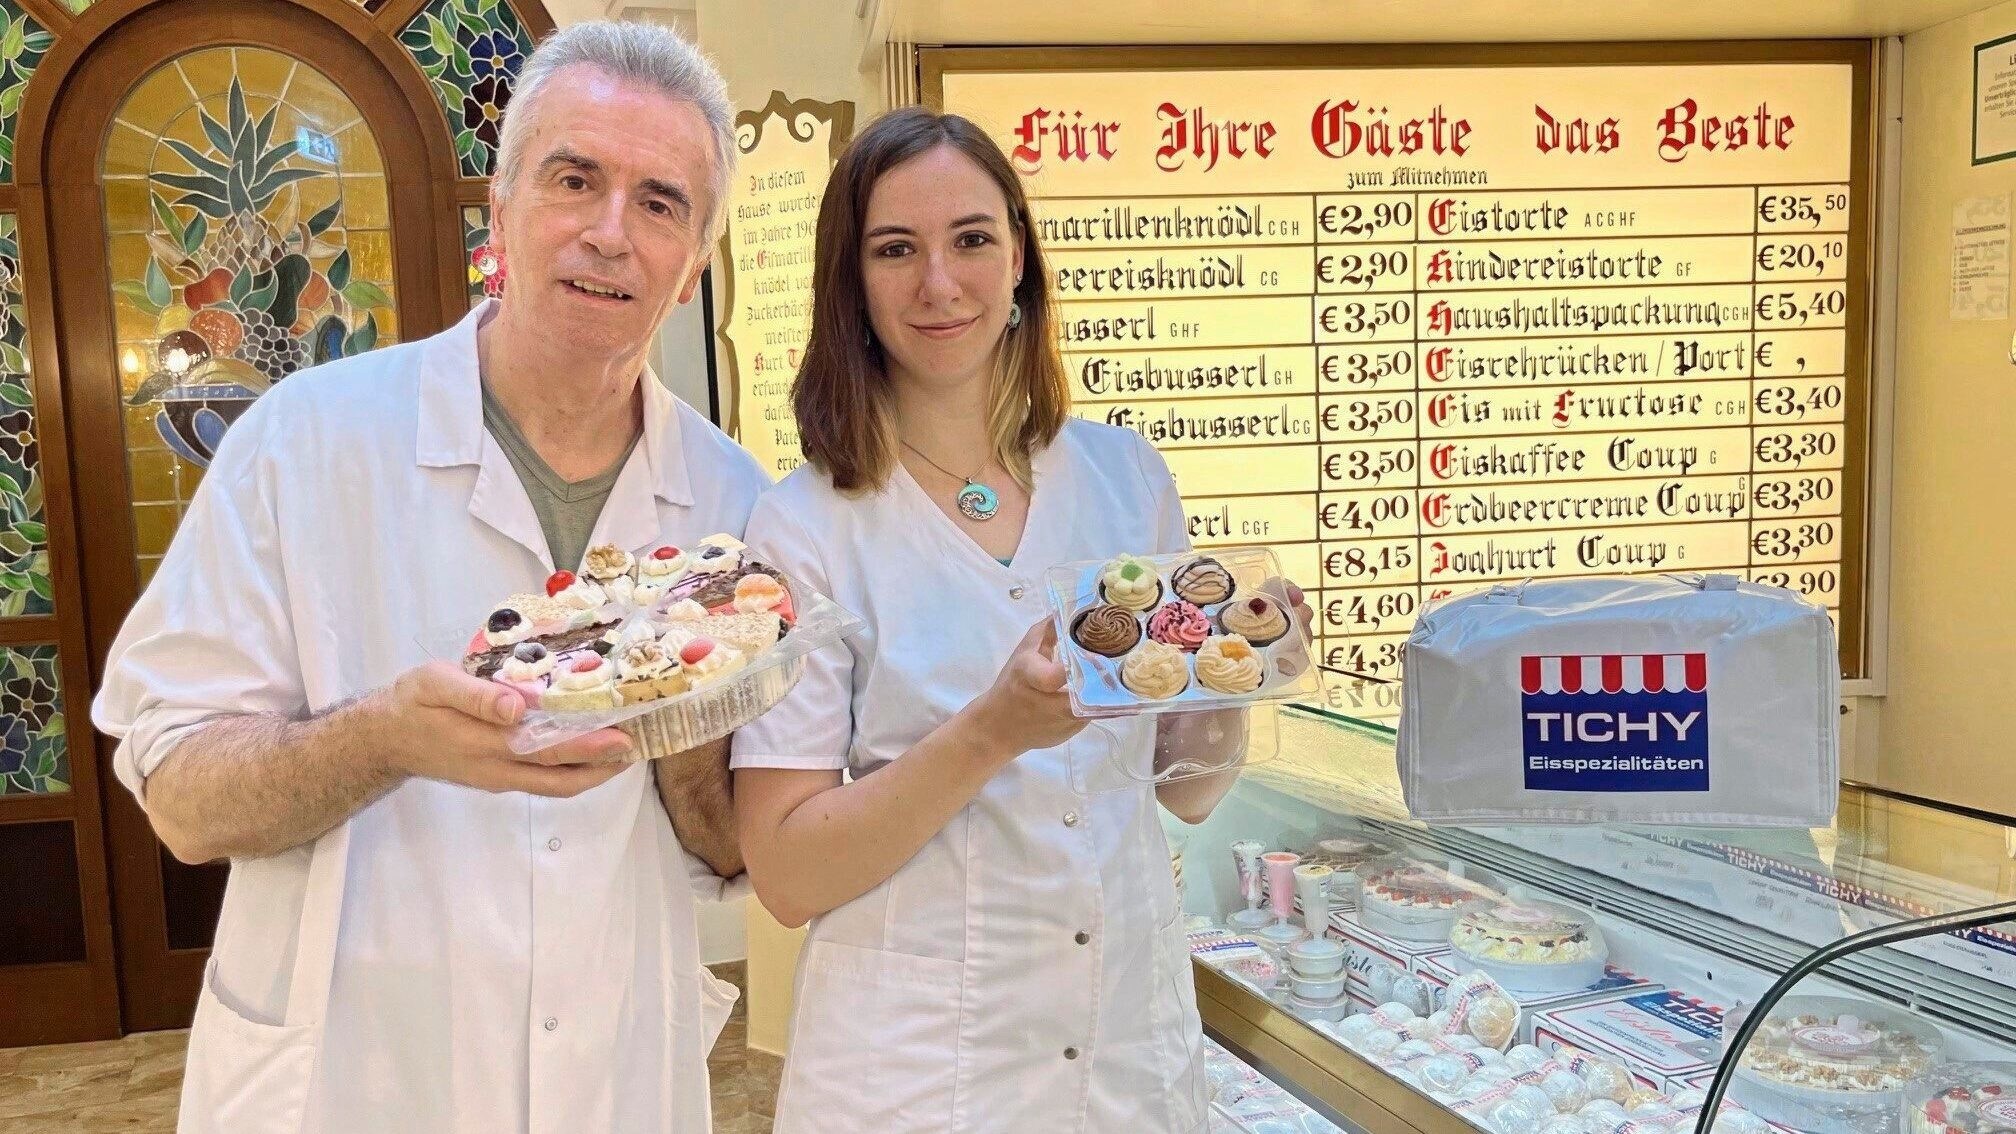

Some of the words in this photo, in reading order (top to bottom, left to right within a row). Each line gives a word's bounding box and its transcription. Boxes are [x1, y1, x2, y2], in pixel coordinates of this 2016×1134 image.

[1012, 106, 1121, 175] Für
[1155, 102, 1278, 173] Ihre
[1311, 98, 1472, 159] Gäste
[1535, 102, 1620, 156] das
[1657, 97, 1795, 163] Beste
[1347, 167, 1383, 190] zum
[1390, 165, 1488, 187] Mitnehmen
[1318, 200, 1412, 240] €2,90
[1427, 197, 1569, 236] Eistorte
[1058, 254, 1246, 293] eereisknödl
[1316, 250, 1409, 293] €2,90
[1426, 248, 1663, 289] Kindereistorte
[1319, 301, 1411, 338] €3,50
[1755, 290, 1846, 326] €5,40
[1082, 352, 1269, 394] Eisbusserl
[1321, 350, 1412, 388] €3,50
[1425, 339, 1649, 383] Eisrehrücken
[1673, 339, 1745, 378] Port
[1321, 399, 1413, 437] €3,50
[1427, 391, 1491, 429] Eis
[1502, 399, 1542, 422] mit
[1552, 388, 1703, 429] Fructose
[1755, 384, 1842, 421] €3,40
[1322, 447, 1415, 486] €3,50
[1429, 441, 1586, 480] Eiskaffee
[1608, 435, 1698, 475] Coup
[1755, 432, 1836, 468] €3,30
[1422, 488, 1648, 529] Erdbeercreme
[1656, 481, 1746, 517] Coup
[1753, 477, 1834, 513] €3,30
[1319, 495, 1409, 537] €4,00
[1430, 536, 1556, 576] Joghurt
[1577, 533, 1667, 569] Coup
[1751, 523, 1834, 560] €3,30
[1324, 545, 1411, 582] €8,15
[1325, 591, 1414, 635] €4,60
[1527, 710, 1702, 743] TICHY
[1529, 755, 1704, 774] Eisspezialitäten
[1727, 853, 1767, 874] TICHY
[1816, 881, 1863, 903] TICHY
[1664, 999, 1722, 1027] TIC
